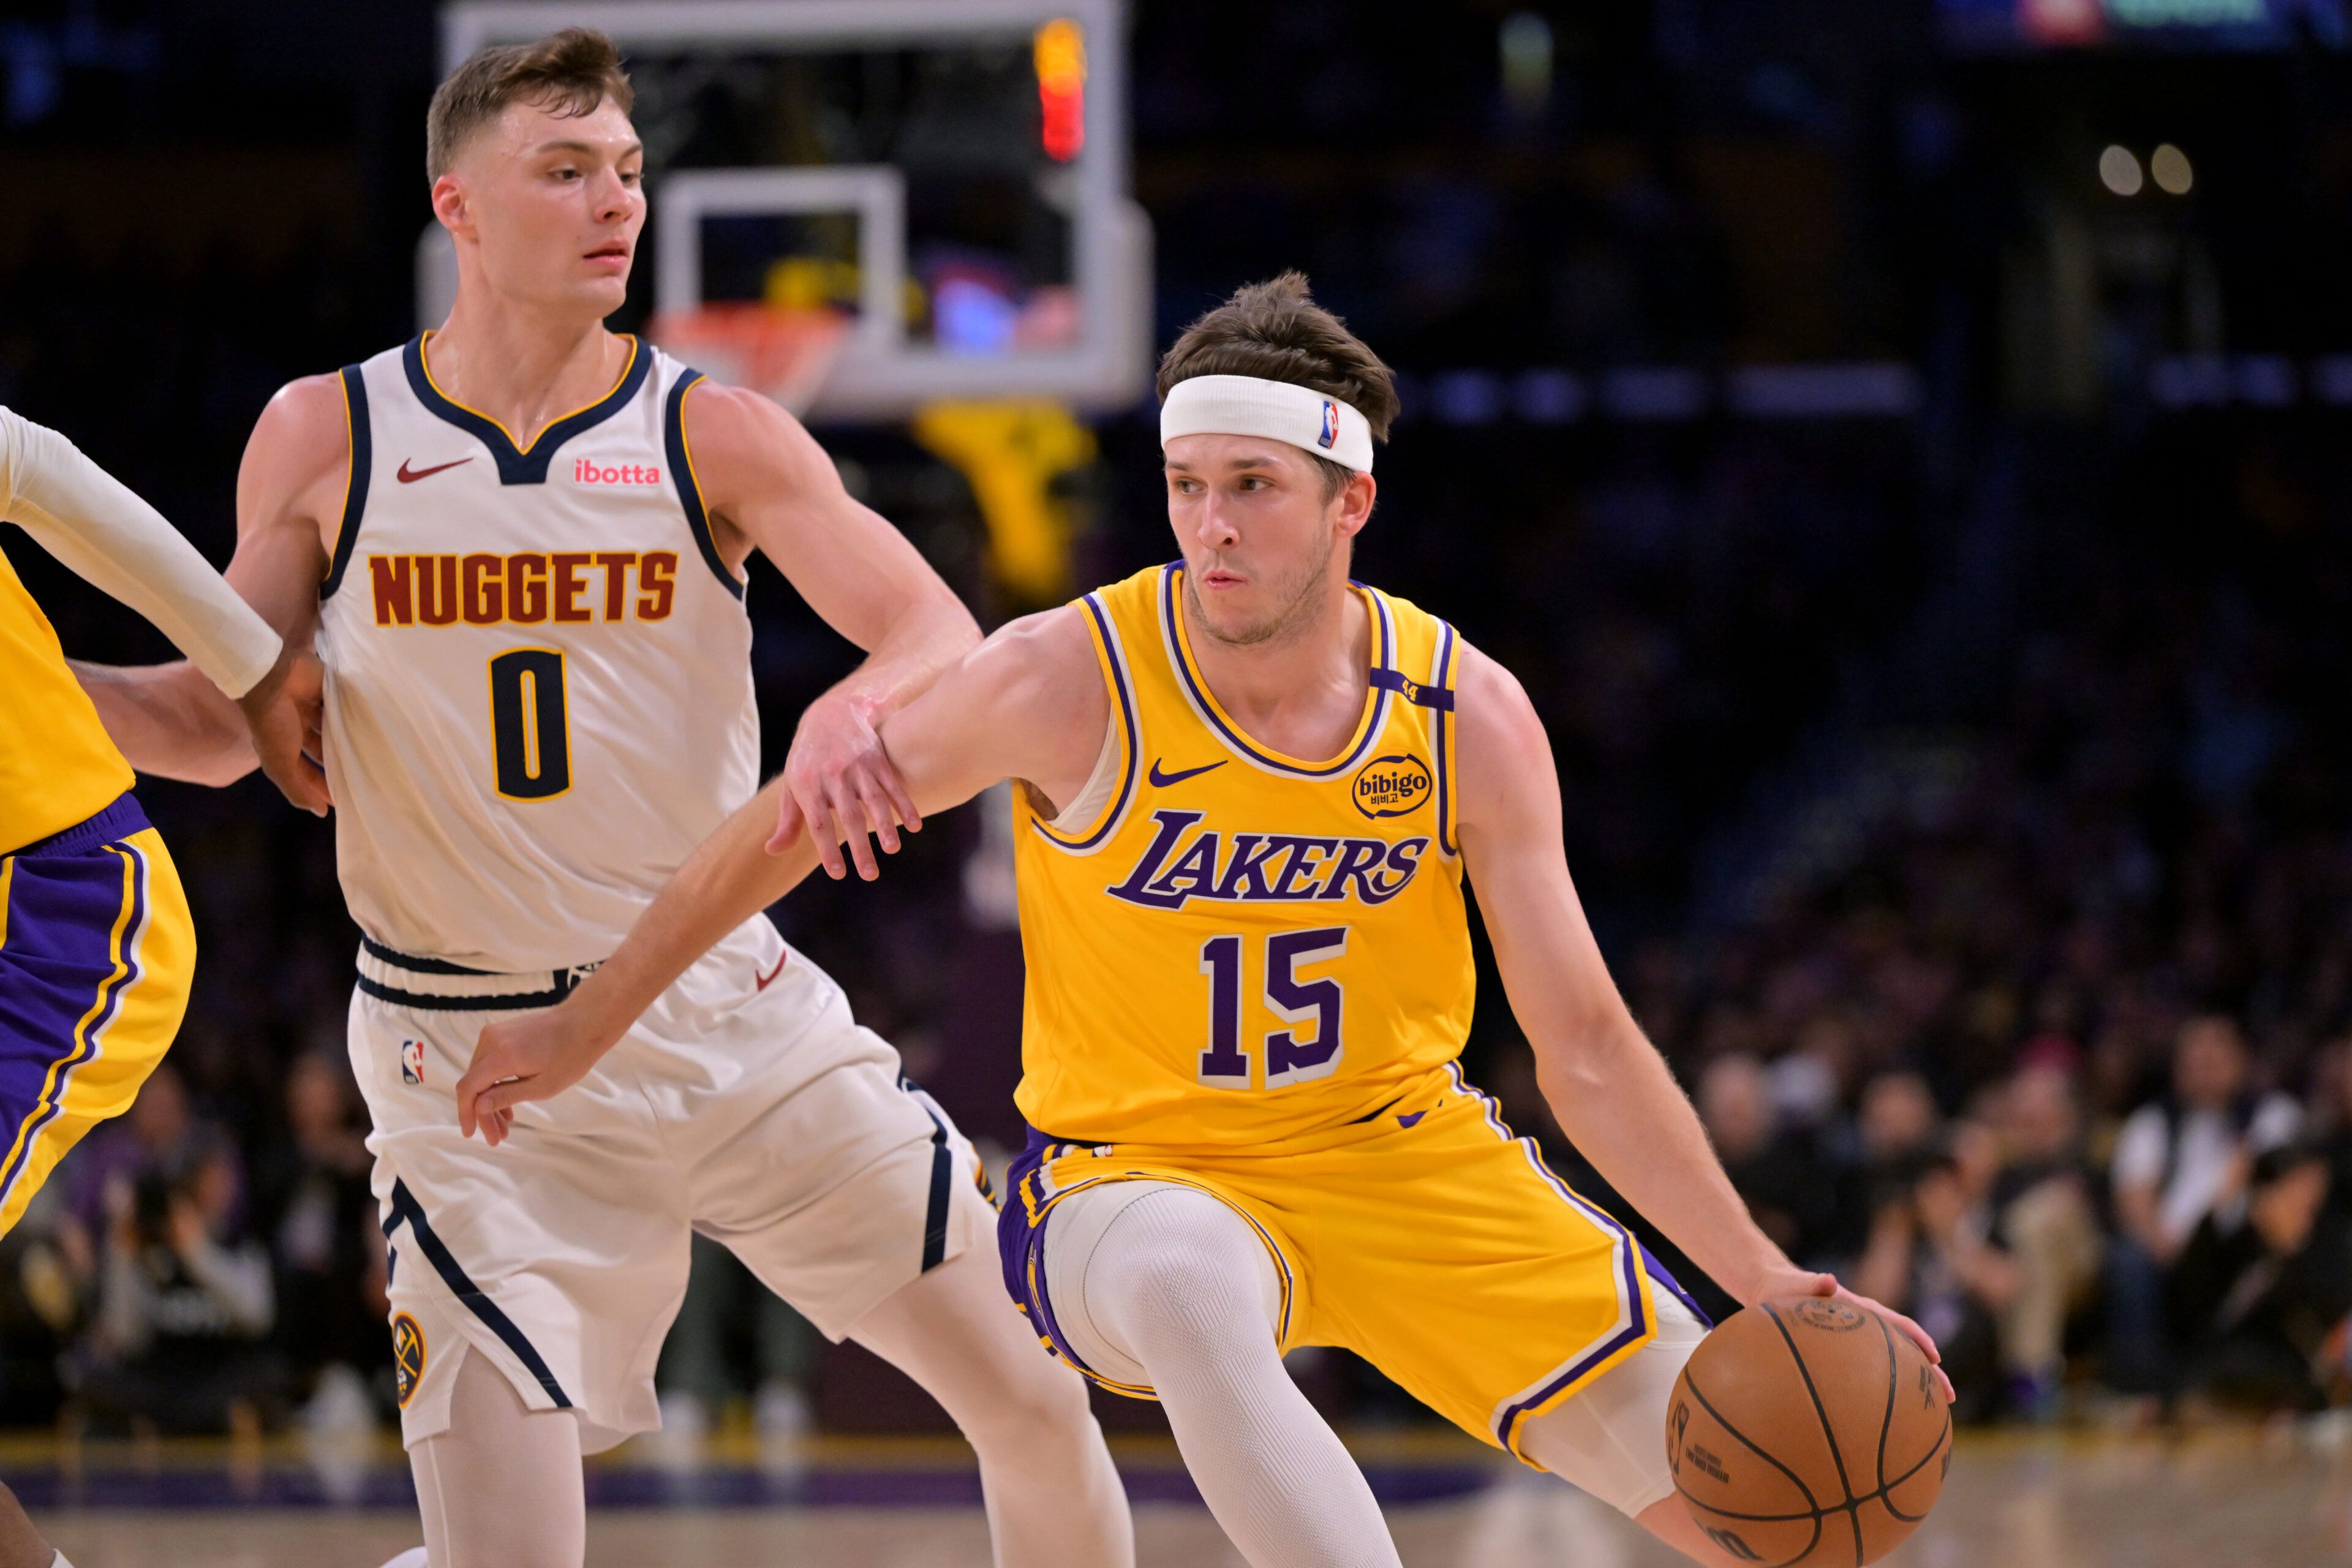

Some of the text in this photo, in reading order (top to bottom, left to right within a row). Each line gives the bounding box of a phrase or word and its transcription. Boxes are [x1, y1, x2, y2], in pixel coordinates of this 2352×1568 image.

[575, 460, 660, 484] ibotta
[369, 551, 679, 627] NUGGETS
[488, 646, 573, 803] 0
[1360, 772, 1427, 797] bibigo
[1371, 793, 1398, 805] 비비고
[1105, 809, 1431, 911] LAKERS
[1198, 925, 1352, 1090] 15
